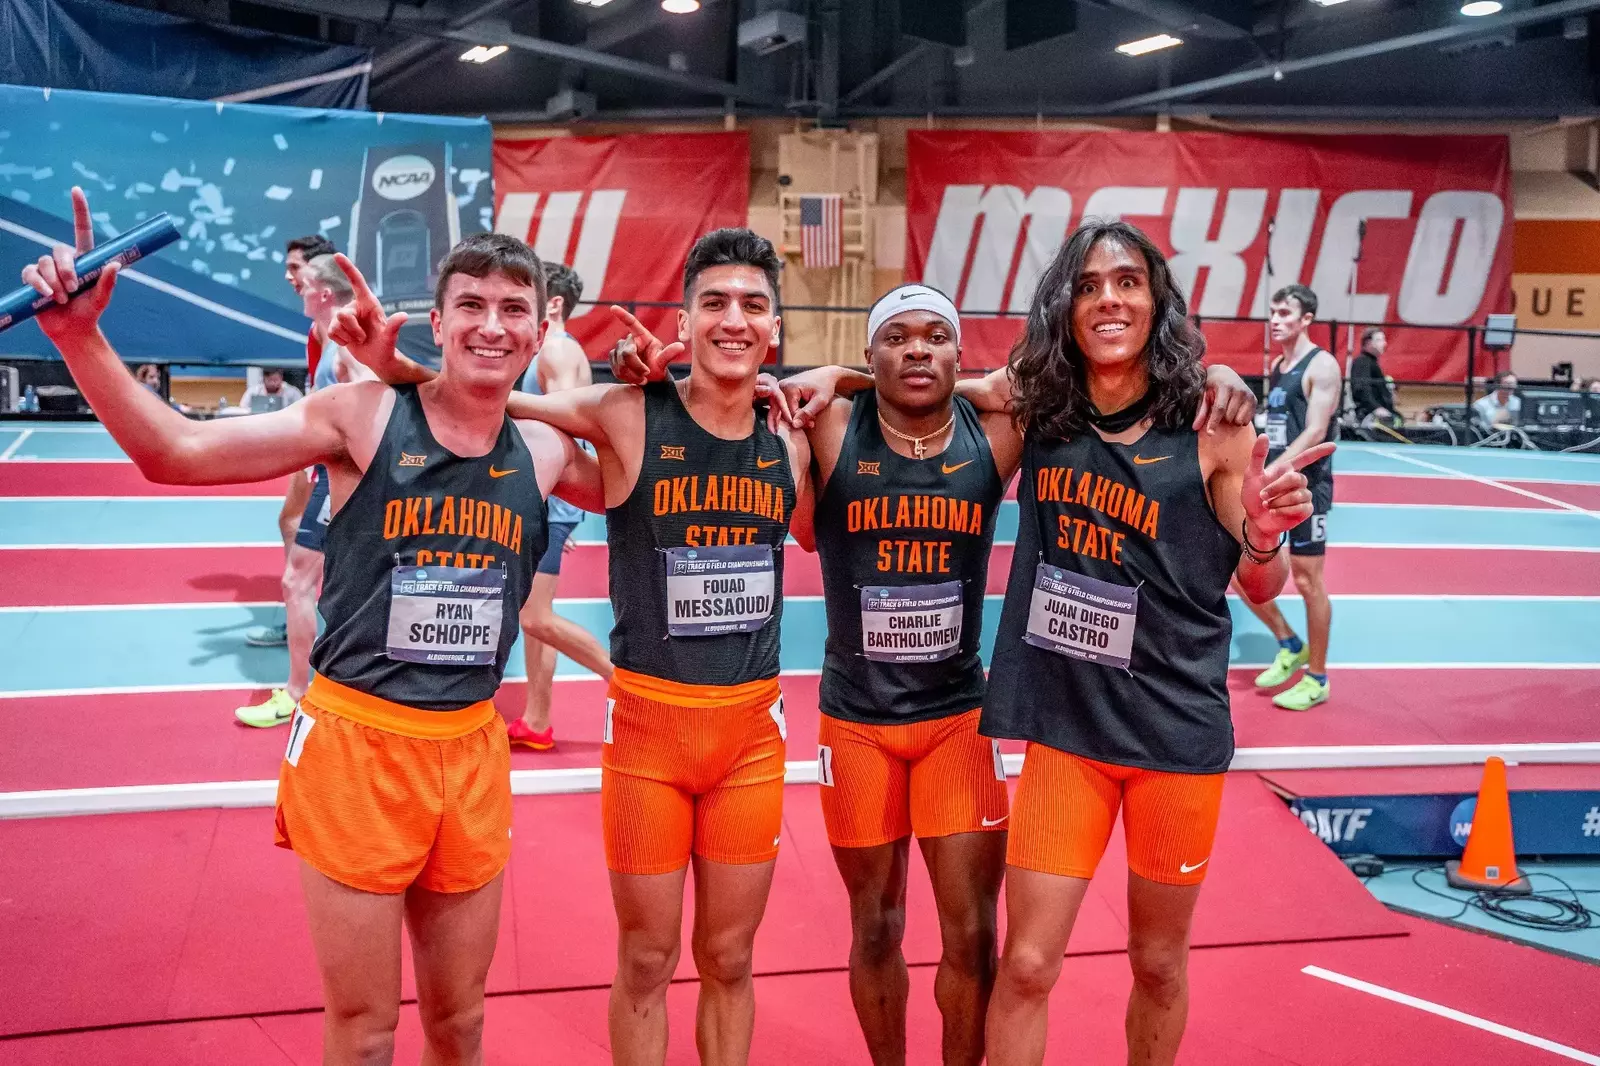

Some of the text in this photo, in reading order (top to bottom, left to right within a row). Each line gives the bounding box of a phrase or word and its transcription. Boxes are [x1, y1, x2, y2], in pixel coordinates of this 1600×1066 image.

[379, 172, 431, 189] NCAA
[1510, 287, 1586, 316] UE
[653, 475, 784, 524] OKLAHOMA
[1037, 467, 1160, 540] OKLAHOMA
[383, 496, 523, 555] OKLAHOMA
[847, 495, 982, 536] OKLAHOMA
[1316, 517, 1325, 539] 5
[1056, 514, 1126, 566] STATE
[727, 560, 769, 569] CHAMPIONSHIPS
[877, 540, 952, 573] STATE
[415, 583, 437, 592] TRACK
[443, 584, 459, 592] FIELD
[460, 586, 502, 594] CHAMPIONSHIPS
[703, 578, 746, 595] FOUAD
[1050, 582, 1067, 592] TRACK
[1072, 588, 1086, 598] FIELD
[1085, 593, 1132, 610] CHAMPIONSHIPS
[435, 602, 473, 621] RYAN
[675, 594, 770, 618] MESSAOUDI
[1044, 598, 1119, 631] JUAN DIEGO
[409, 622, 490, 645] SCHOPPE
[889, 613, 942, 629] CHARLIE
[1048, 617, 1109, 649] CASTRO
[867, 625, 960, 648] BARTHOLOMEW
[287, 714, 305, 758] 1
[819, 748, 828, 784] 1
[1290, 807, 1374, 844] ATF
